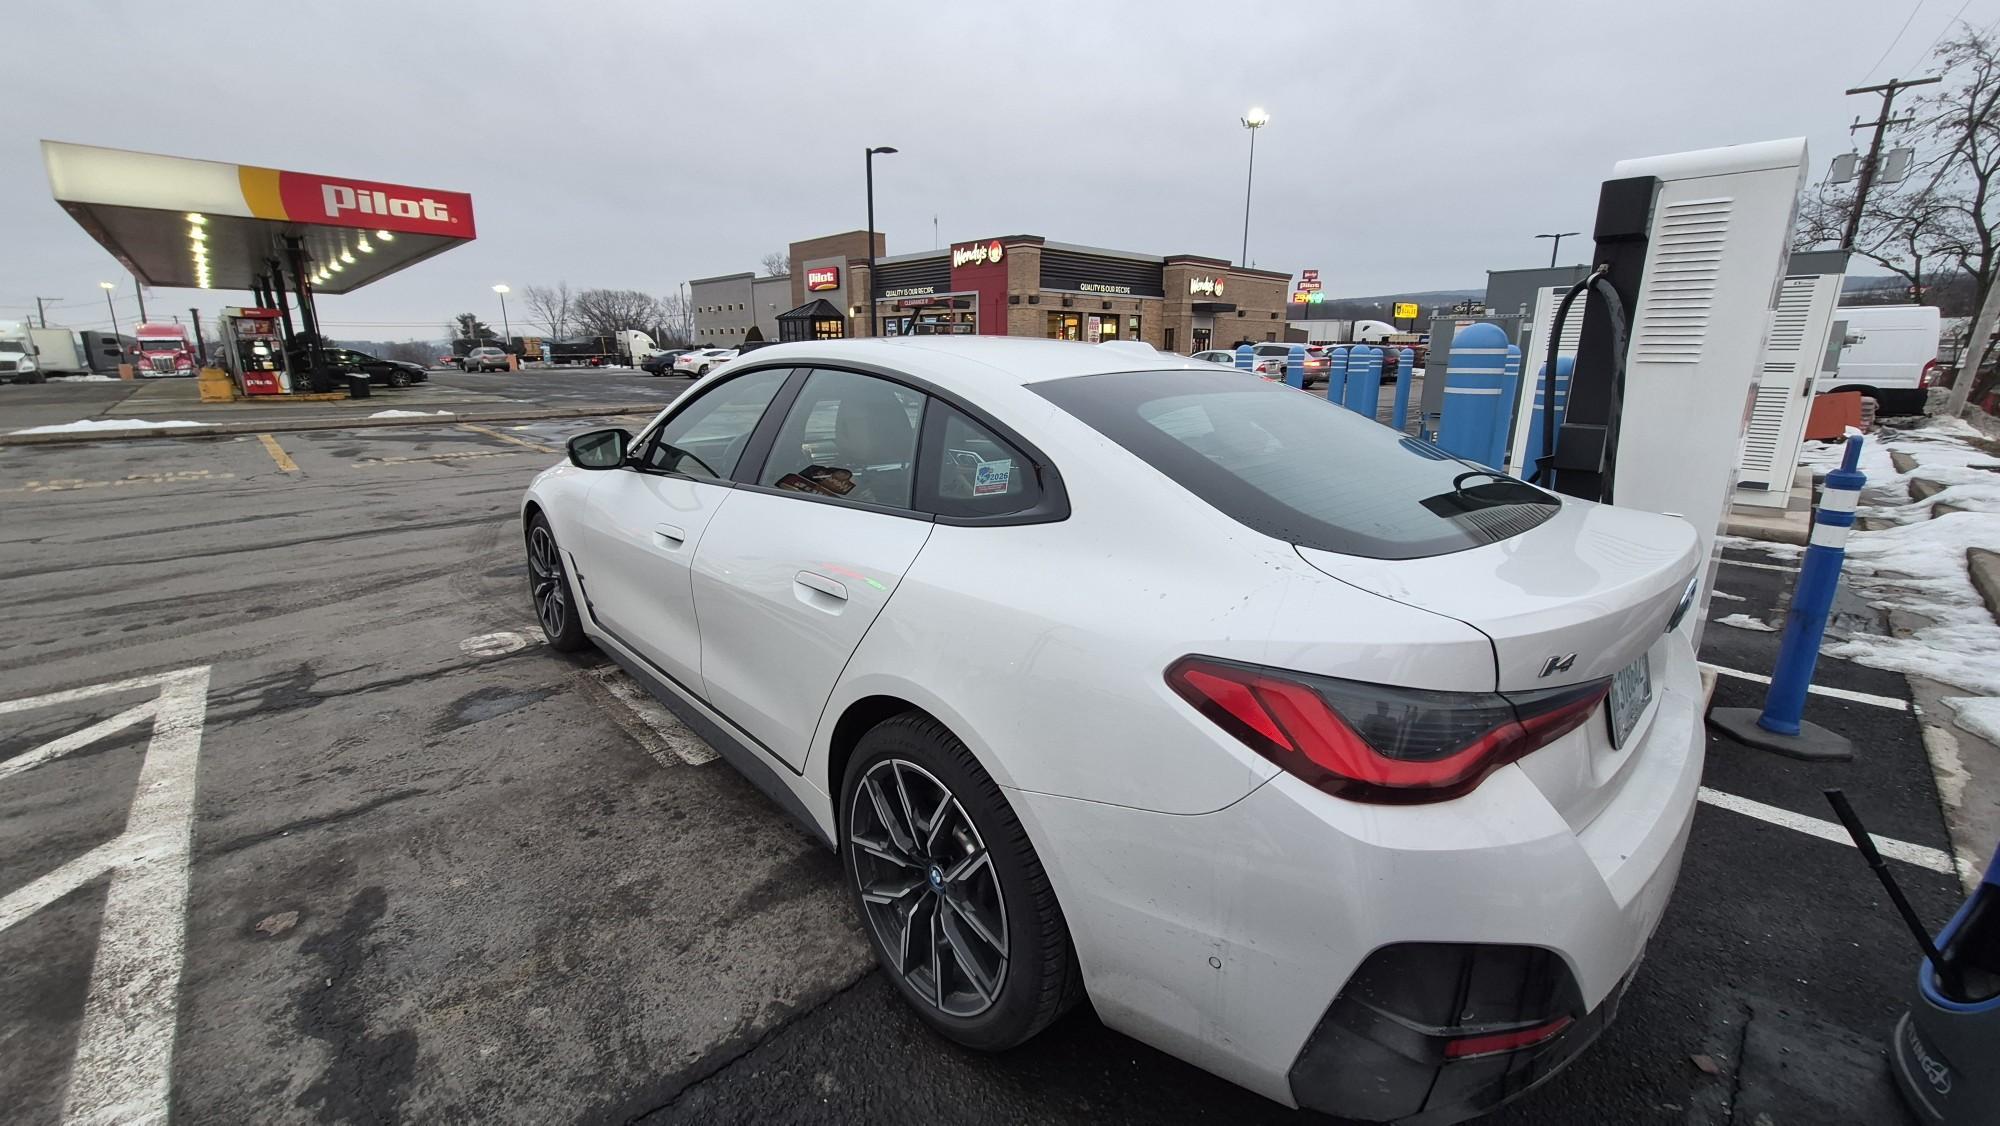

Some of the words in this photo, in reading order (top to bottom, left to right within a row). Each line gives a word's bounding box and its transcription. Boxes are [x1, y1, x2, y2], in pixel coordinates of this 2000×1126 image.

[321, 183, 449, 221] Pilot
[953, 242, 987, 268] Wendy's
[808, 272, 834, 286] Pilot
[1190, 276, 1214, 295] Wendy's
[885, 289, 904, 297] QUALITY
[918, 286, 934, 294] RECIPE
[1080, 283, 1100, 291] QUALITY
[1105, 285, 1115, 293] OUR
[1115, 286, 1130, 294] RECIPE
[990, 472, 1008, 481] 2026
